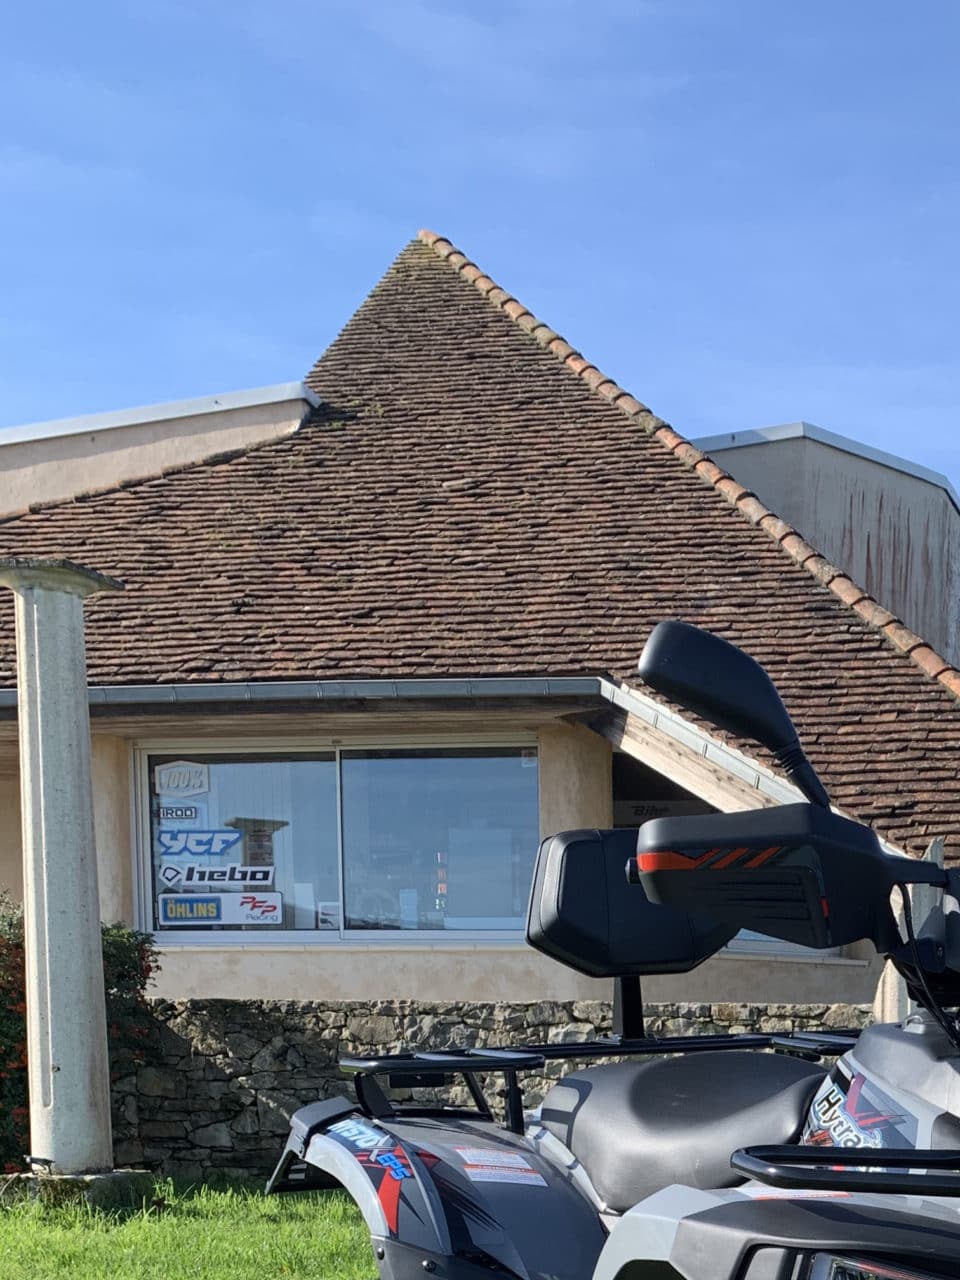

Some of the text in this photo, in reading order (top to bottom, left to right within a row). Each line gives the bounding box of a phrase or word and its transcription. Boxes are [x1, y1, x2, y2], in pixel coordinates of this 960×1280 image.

[185, 866, 270, 882] hebo
[167, 901, 217, 918] ÖHLINS
[246, 914, 278, 922] Racing
[814, 1086, 873, 1148] Hytra
[376, 1153, 413, 1180] EPS
